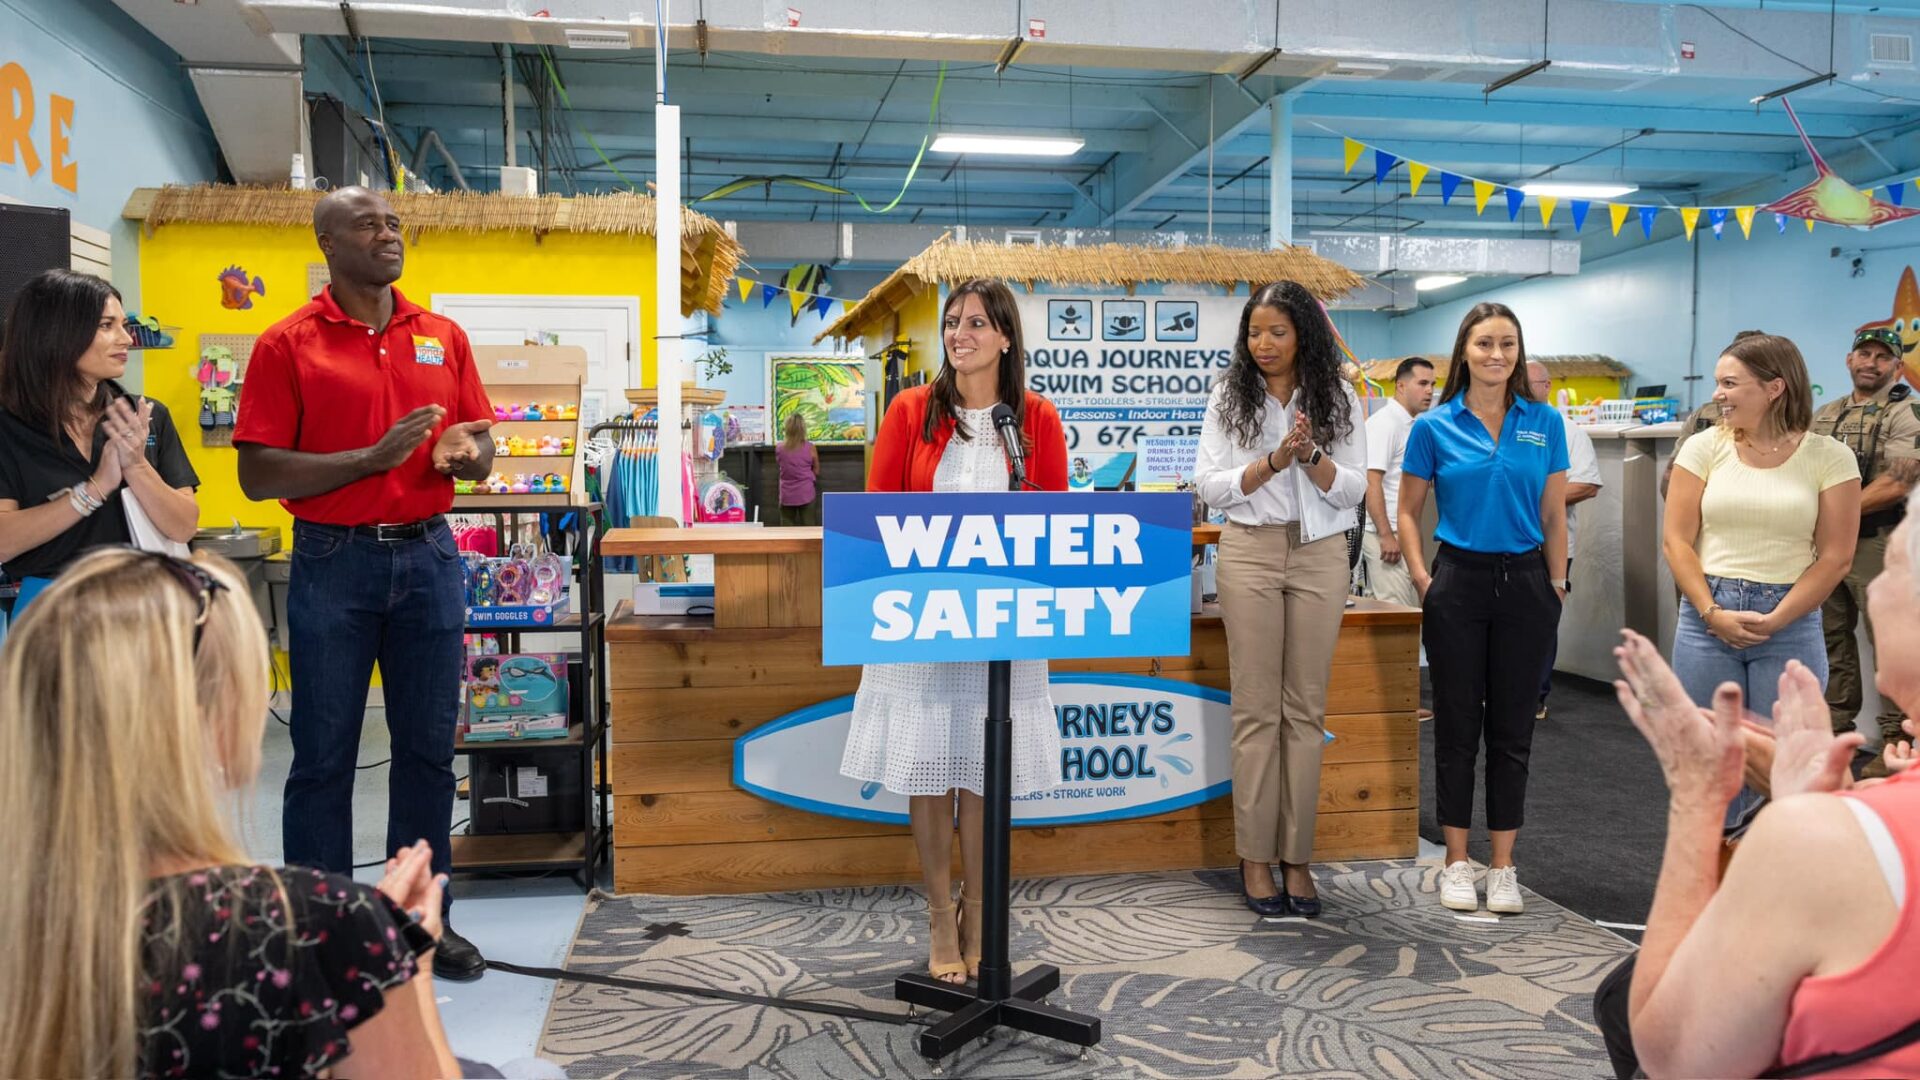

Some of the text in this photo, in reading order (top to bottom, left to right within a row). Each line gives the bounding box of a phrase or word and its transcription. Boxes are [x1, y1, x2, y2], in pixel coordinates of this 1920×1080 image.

[1097, 349, 1231, 369] JOURNEYS
[1030, 374, 1213, 394] SWIM SCHOOL
[1051, 397, 1208, 405] NTS TODDLERS STROKE WOR
[1065, 410, 1116, 420] Lessons
[1128, 409, 1170, 419] Indoor
[875, 513, 1143, 568] WATER
[472, 611, 529, 621] SWIM GOGGLES
[871, 586, 1146, 641] SAFETY
[1061, 744, 1156, 782] HOOL
[1053, 788, 1094, 799] STROKE
[1096, 786, 1126, 797] WORK
